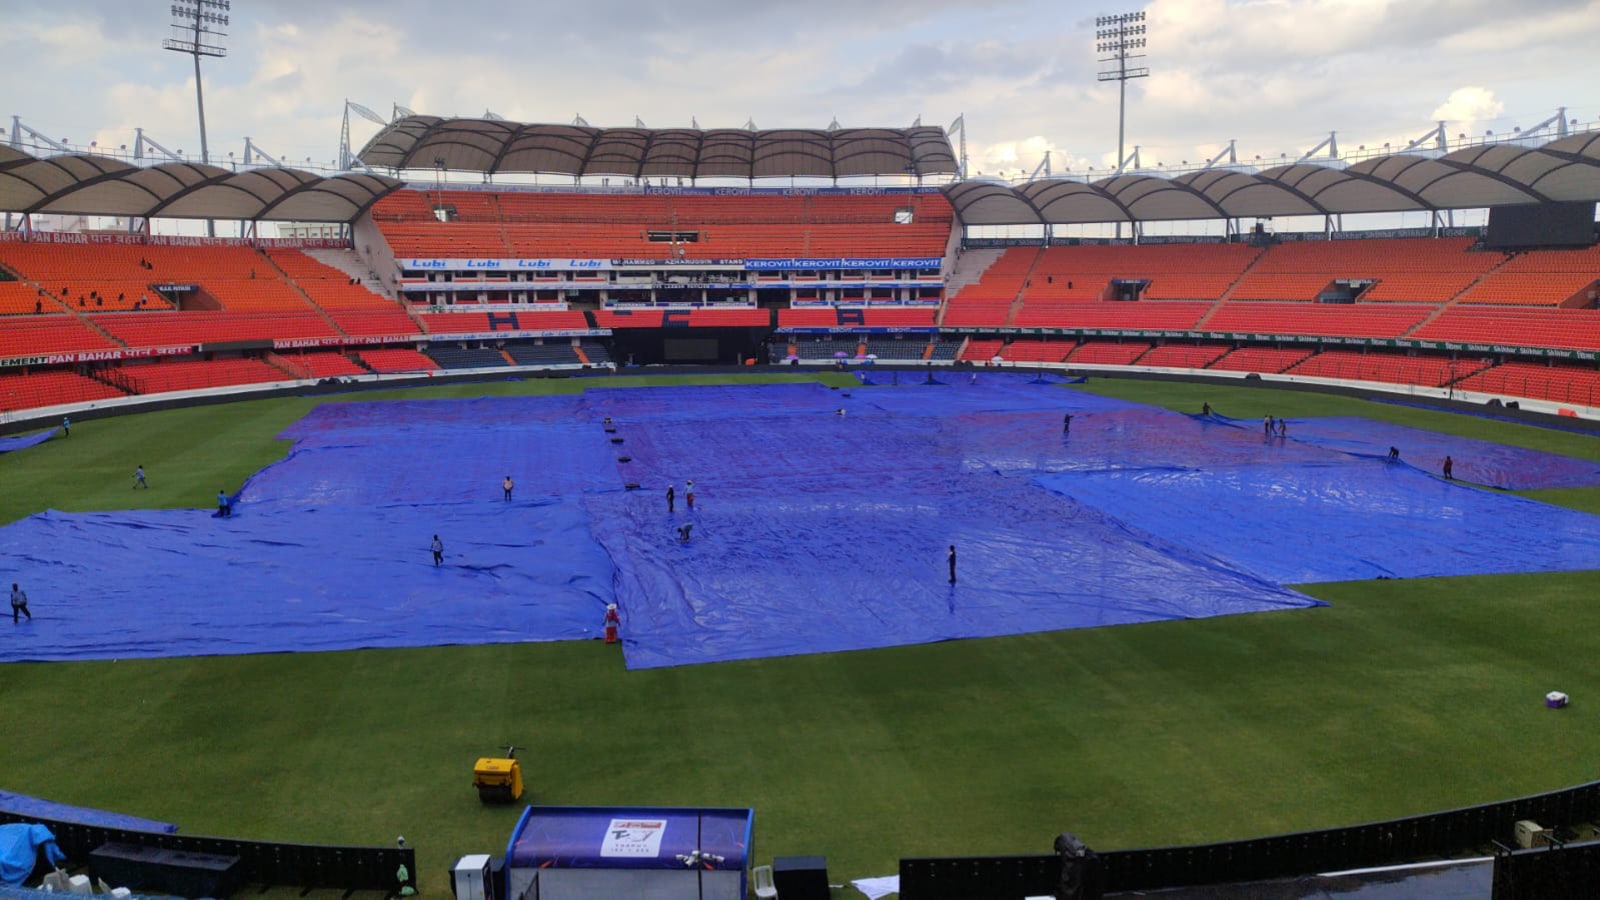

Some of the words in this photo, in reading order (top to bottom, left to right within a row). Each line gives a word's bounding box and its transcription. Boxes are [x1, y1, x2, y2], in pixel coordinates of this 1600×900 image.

[646, 187, 682, 195] KEROVIT
[851, 187, 886, 195] KEROVIT
[31, 233, 50, 242] PAN
[54, 233, 88, 244] BAHAR
[150, 236, 167, 245] PAN
[170, 237, 201, 246] BAHAR
[255, 239, 272, 247] PAN
[275, 239, 303, 248] BAHAR
[412, 259, 446, 267] Lubi
[467, 259, 499, 267] Lubi
[518, 259, 551, 267] Lubi
[570, 259, 601, 267] Lubi
[746, 259, 792, 267] KEROVIT
[794, 259, 841, 267] KEROVIT
[844, 259, 890, 267] KEROVIT
[892, 258, 939, 267] KEROVIT
[274, 340, 290, 348] PAN
[292, 339, 320, 347] BAHAR
[366, 336, 381, 344] PAN
[383, 335, 409, 343] BAHAR
[1, 356, 48, 366] EMENT
[50, 354, 75, 364] PAN
[78, 351, 121, 361] BAHAR
